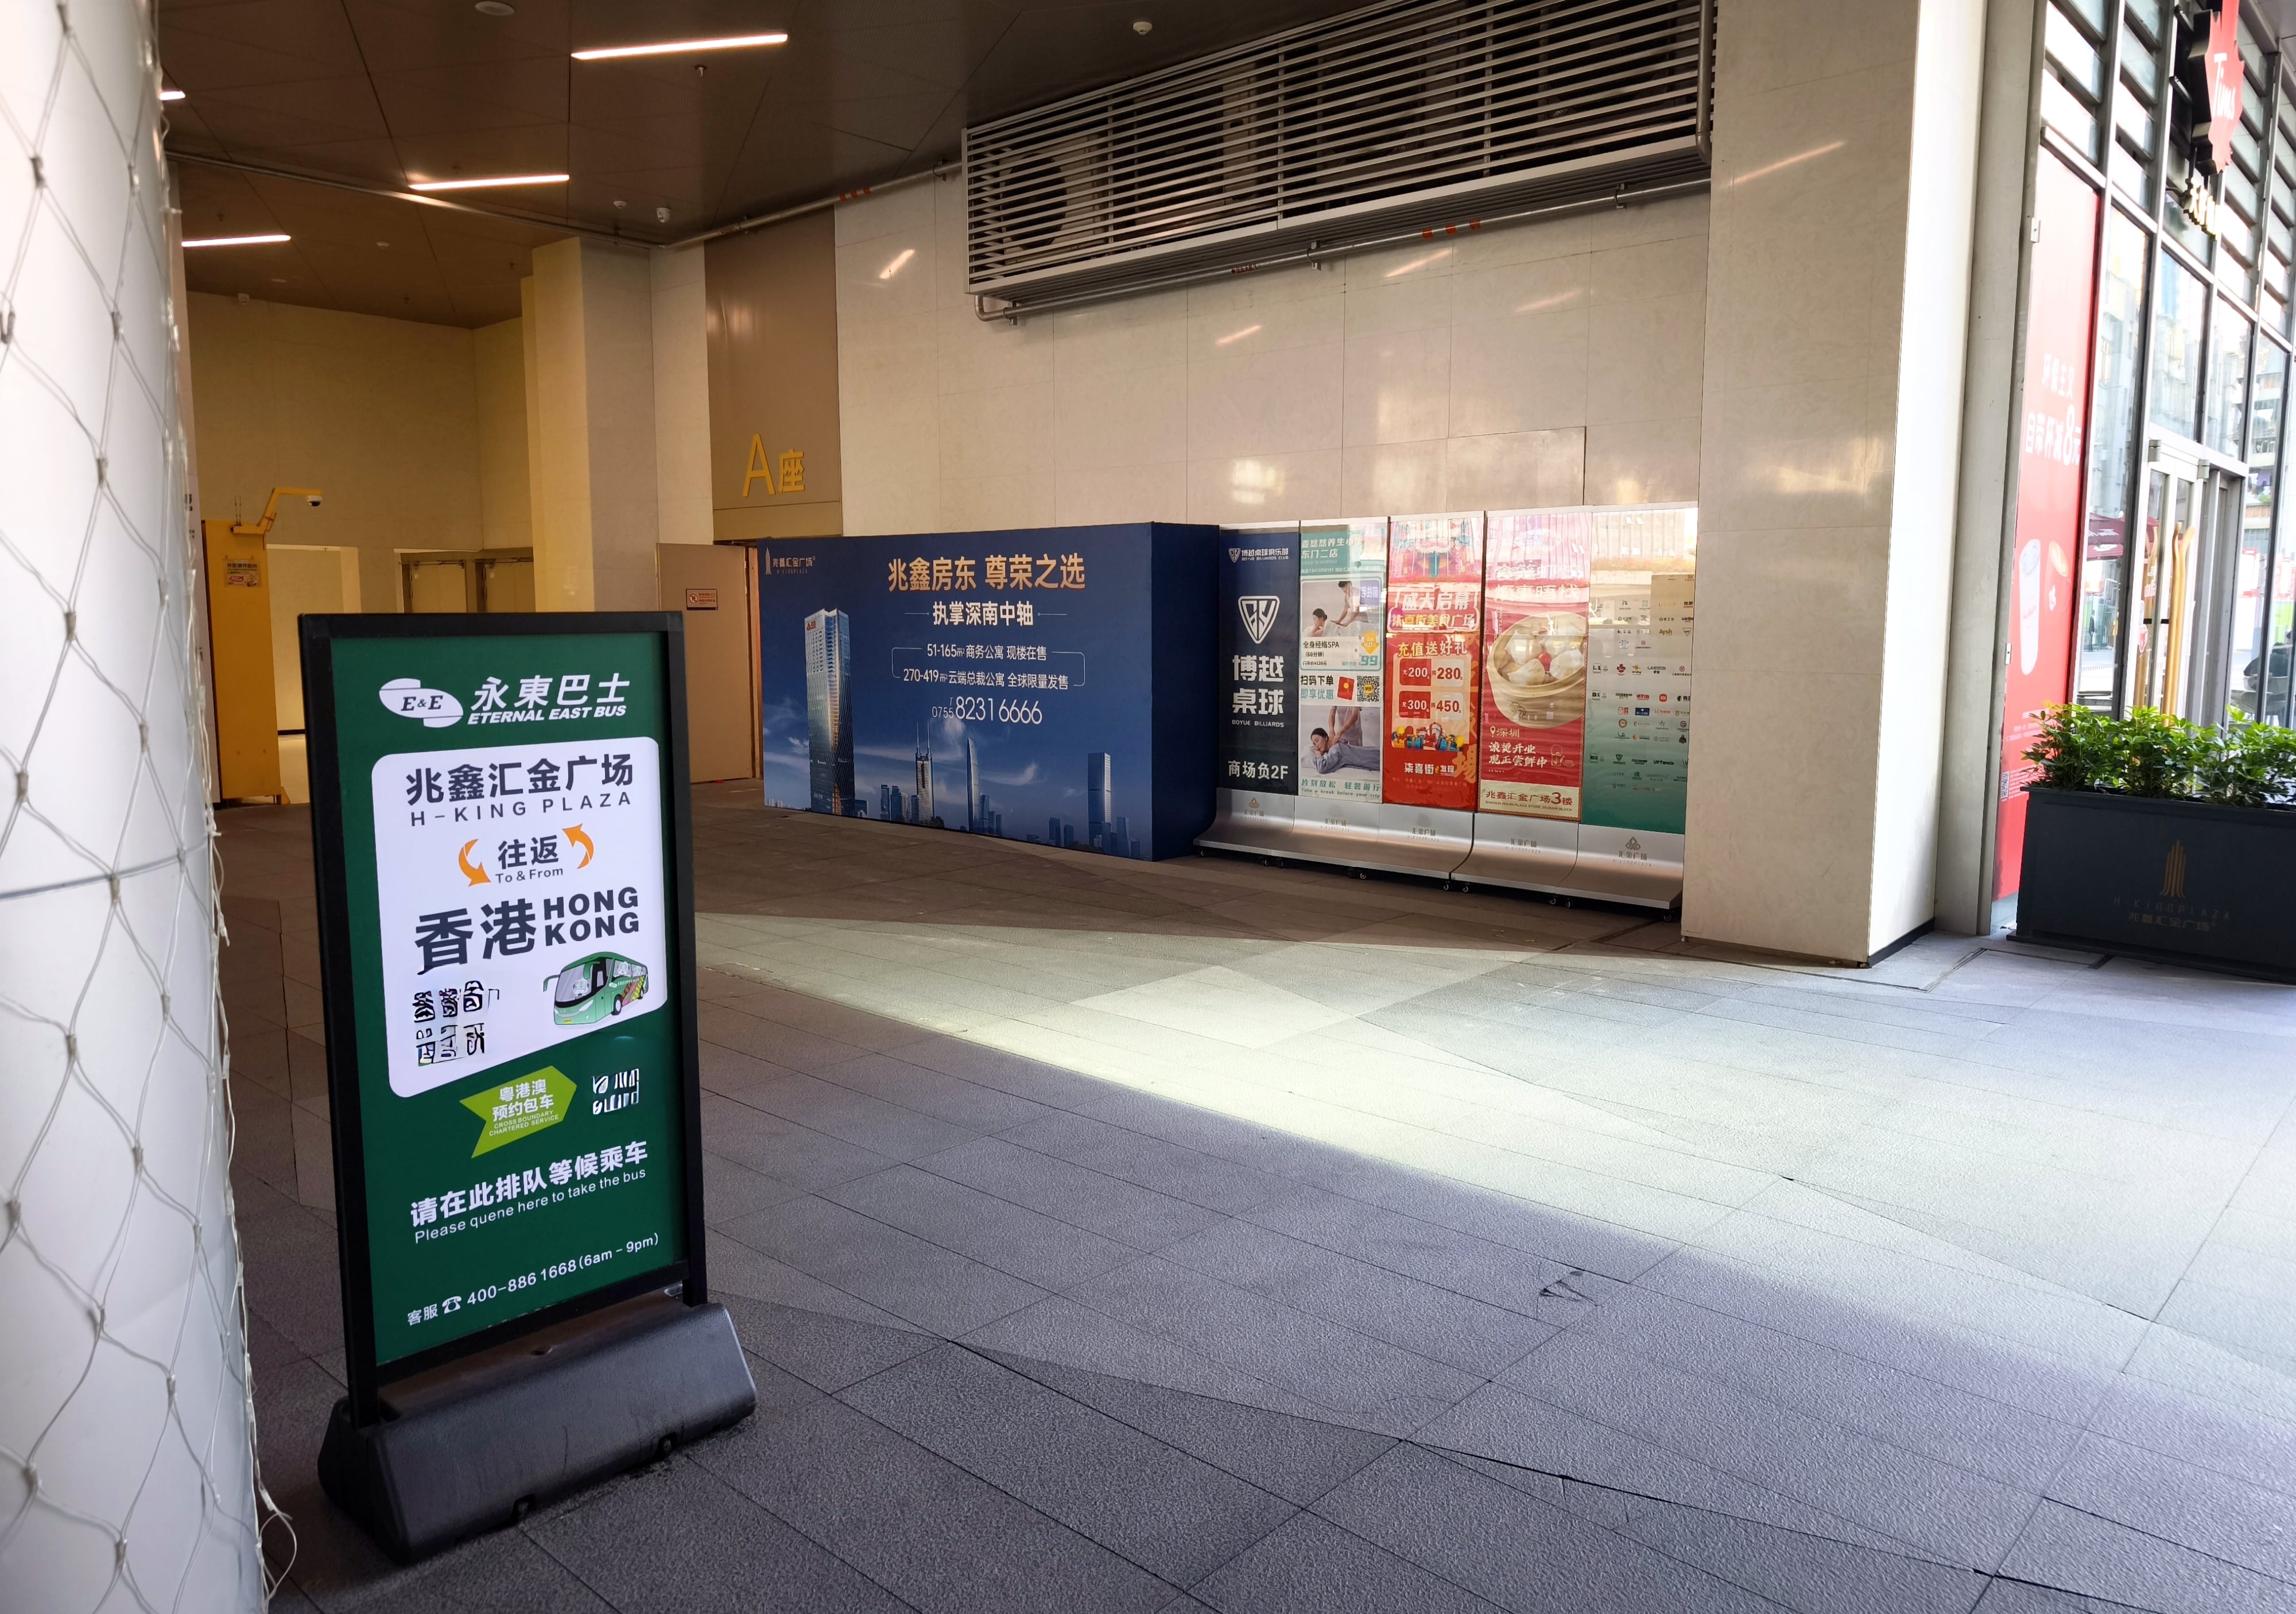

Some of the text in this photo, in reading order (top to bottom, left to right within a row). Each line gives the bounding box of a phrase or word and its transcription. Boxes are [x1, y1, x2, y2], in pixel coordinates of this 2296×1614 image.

[742, 433, 805, 498] A座
[1242, 548, 1289, 557] 博越桌球俱乐部
[1301, 548, 1339, 559] 东门二店
[888, 552, 1086, 592] 兆鑫房东 尊荣之选
[1401, 592, 1471, 611] 盛大启幕
[933, 601, 1034, 626] 执掌深南中轴
[1006, 645, 1047, 661] 现楼在售
[1303, 640, 1340, 649] 全身经络SPA
[1397, 640, 1468, 658] 充值送好礼
[1232, 655, 1284, 682] 博越
[1007, 672, 1069, 690] 全球限量发售
[1300, 675, 1334, 686] 扫码下单
[471, 672, 630, 711] 永東巴士
[1300, 688, 1334, 700] 即享优惠
[1232, 688, 1284, 715] 桌球
[467, 705, 627, 725] ETERNAL EAST BUS
[932, 706, 954, 719] 0755
[1496, 727, 1520, 738] 深圳
[1488, 741, 1537, 755] 滚烫开业
[1228, 760, 1289, 780] 商场负2F
[1404, 762, 1434, 775] 柒喜街
[1488, 754, 1548, 768] 现正尝鲜中
[406, 753, 633, 806] 兆鑫汇金广场
[1301, 779, 1336, 788] 片刻放松
[1344, 781, 1381, 792] 轻装前行
[542, 791, 630, 814] PLAZA
[1486, 790, 1573, 806] 兆鑫汇金广场3楼
[1325, 817, 1347, 827] 汇金广场
[1411, 827, 1436, 837] 汇金广场
[498, 834, 559, 870] 往返
[1510, 838, 1537, 848] 汇金广场
[1618, 850, 1648, 861] 汇金广场
[495, 867, 564, 884] To & From
[544, 887, 638, 920] HONG
[414, 898, 537, 976] 香港
[545, 912, 639, 947] KONG
[499, 1079, 546, 1102] 粤港澳
[492, 1094, 554, 1122] 预约包车
[489, 1114, 559, 1136] CHARTERED SERVICE
[494, 1110, 554, 1129] CROSS BOUNDARY
[410, 1140, 648, 1228] 请在此排队等候乘车
[414, 1168, 646, 1244] Please quene here to take the bus
[407, 1303, 438, 1326] 客服
[467, 1272, 537, 1305] 400-886
